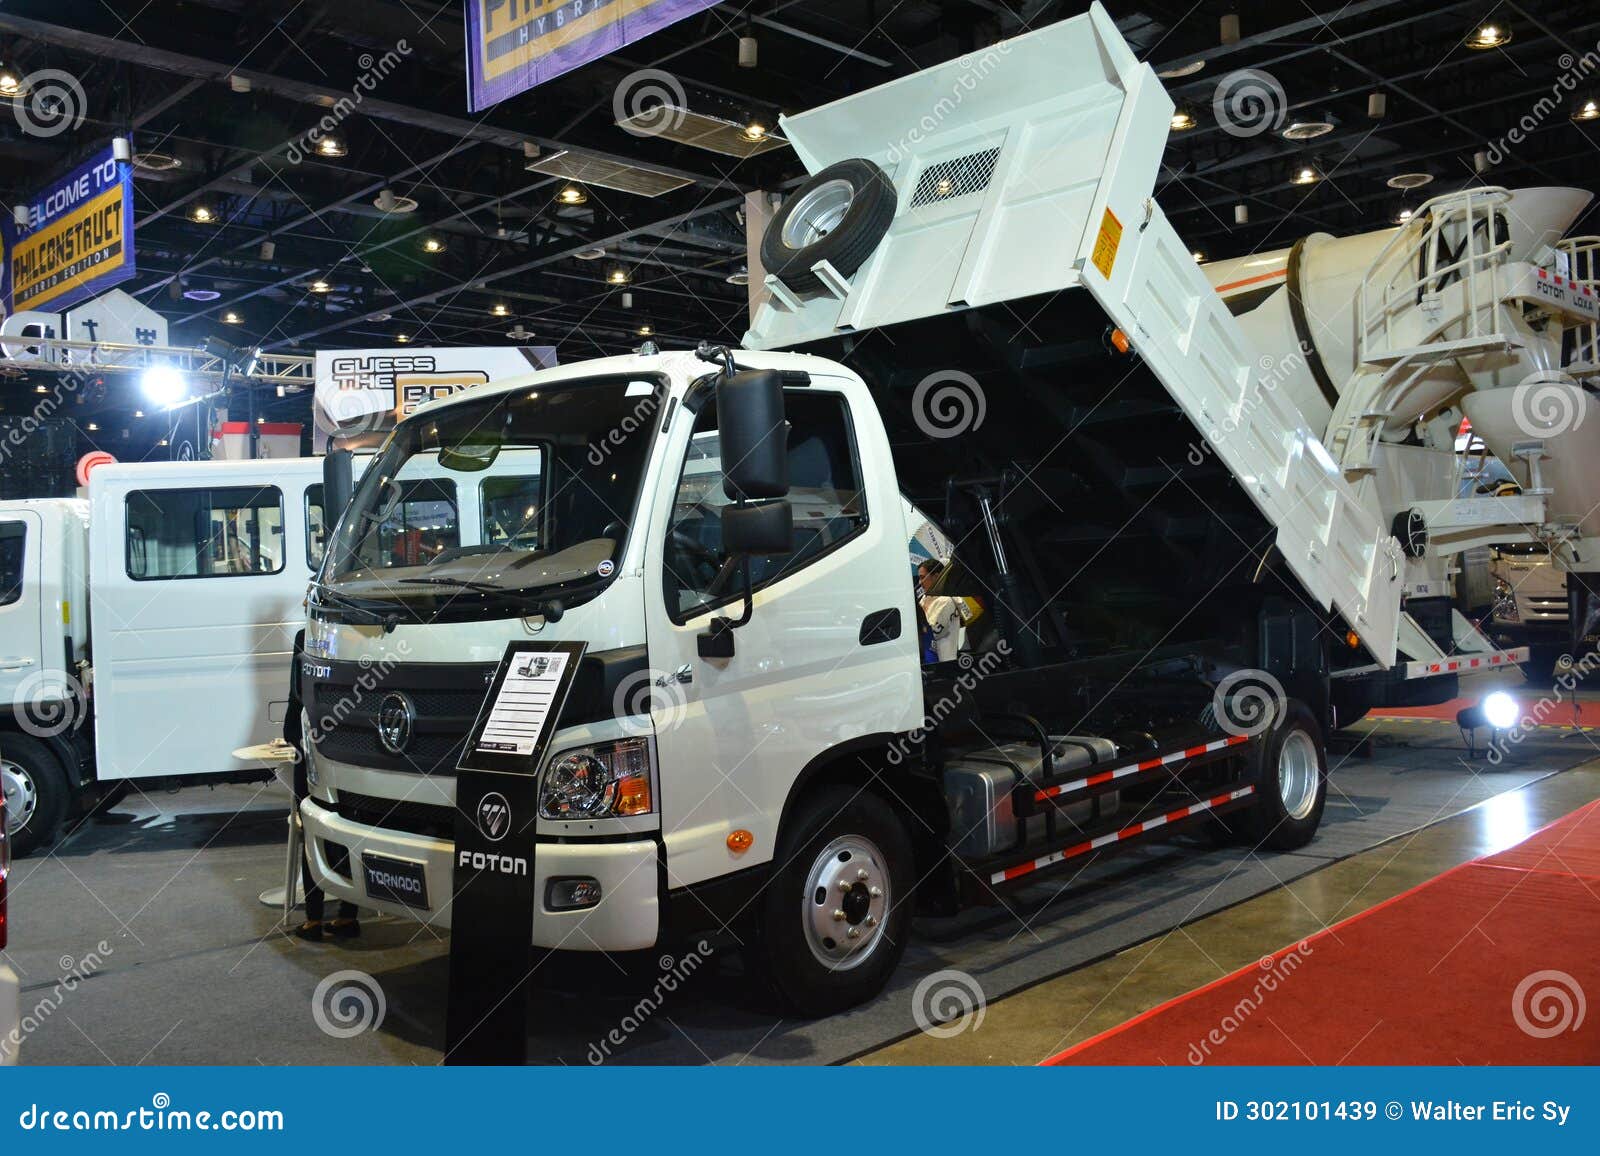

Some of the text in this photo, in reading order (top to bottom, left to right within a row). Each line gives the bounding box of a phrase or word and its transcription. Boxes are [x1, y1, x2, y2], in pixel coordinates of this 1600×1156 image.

[16, 157, 117, 235] ELCOME TO
[13, 200, 122, 289] PHILCONSTRUCT
[64, 247, 109, 280] EDITION
[1537, 280, 1565, 300] FOTON
[332, 356, 436, 374] GUESS
[332, 373, 395, 390] THE
[459, 850, 527, 876] FOTON
[368, 869, 422, 894] TORNADO
